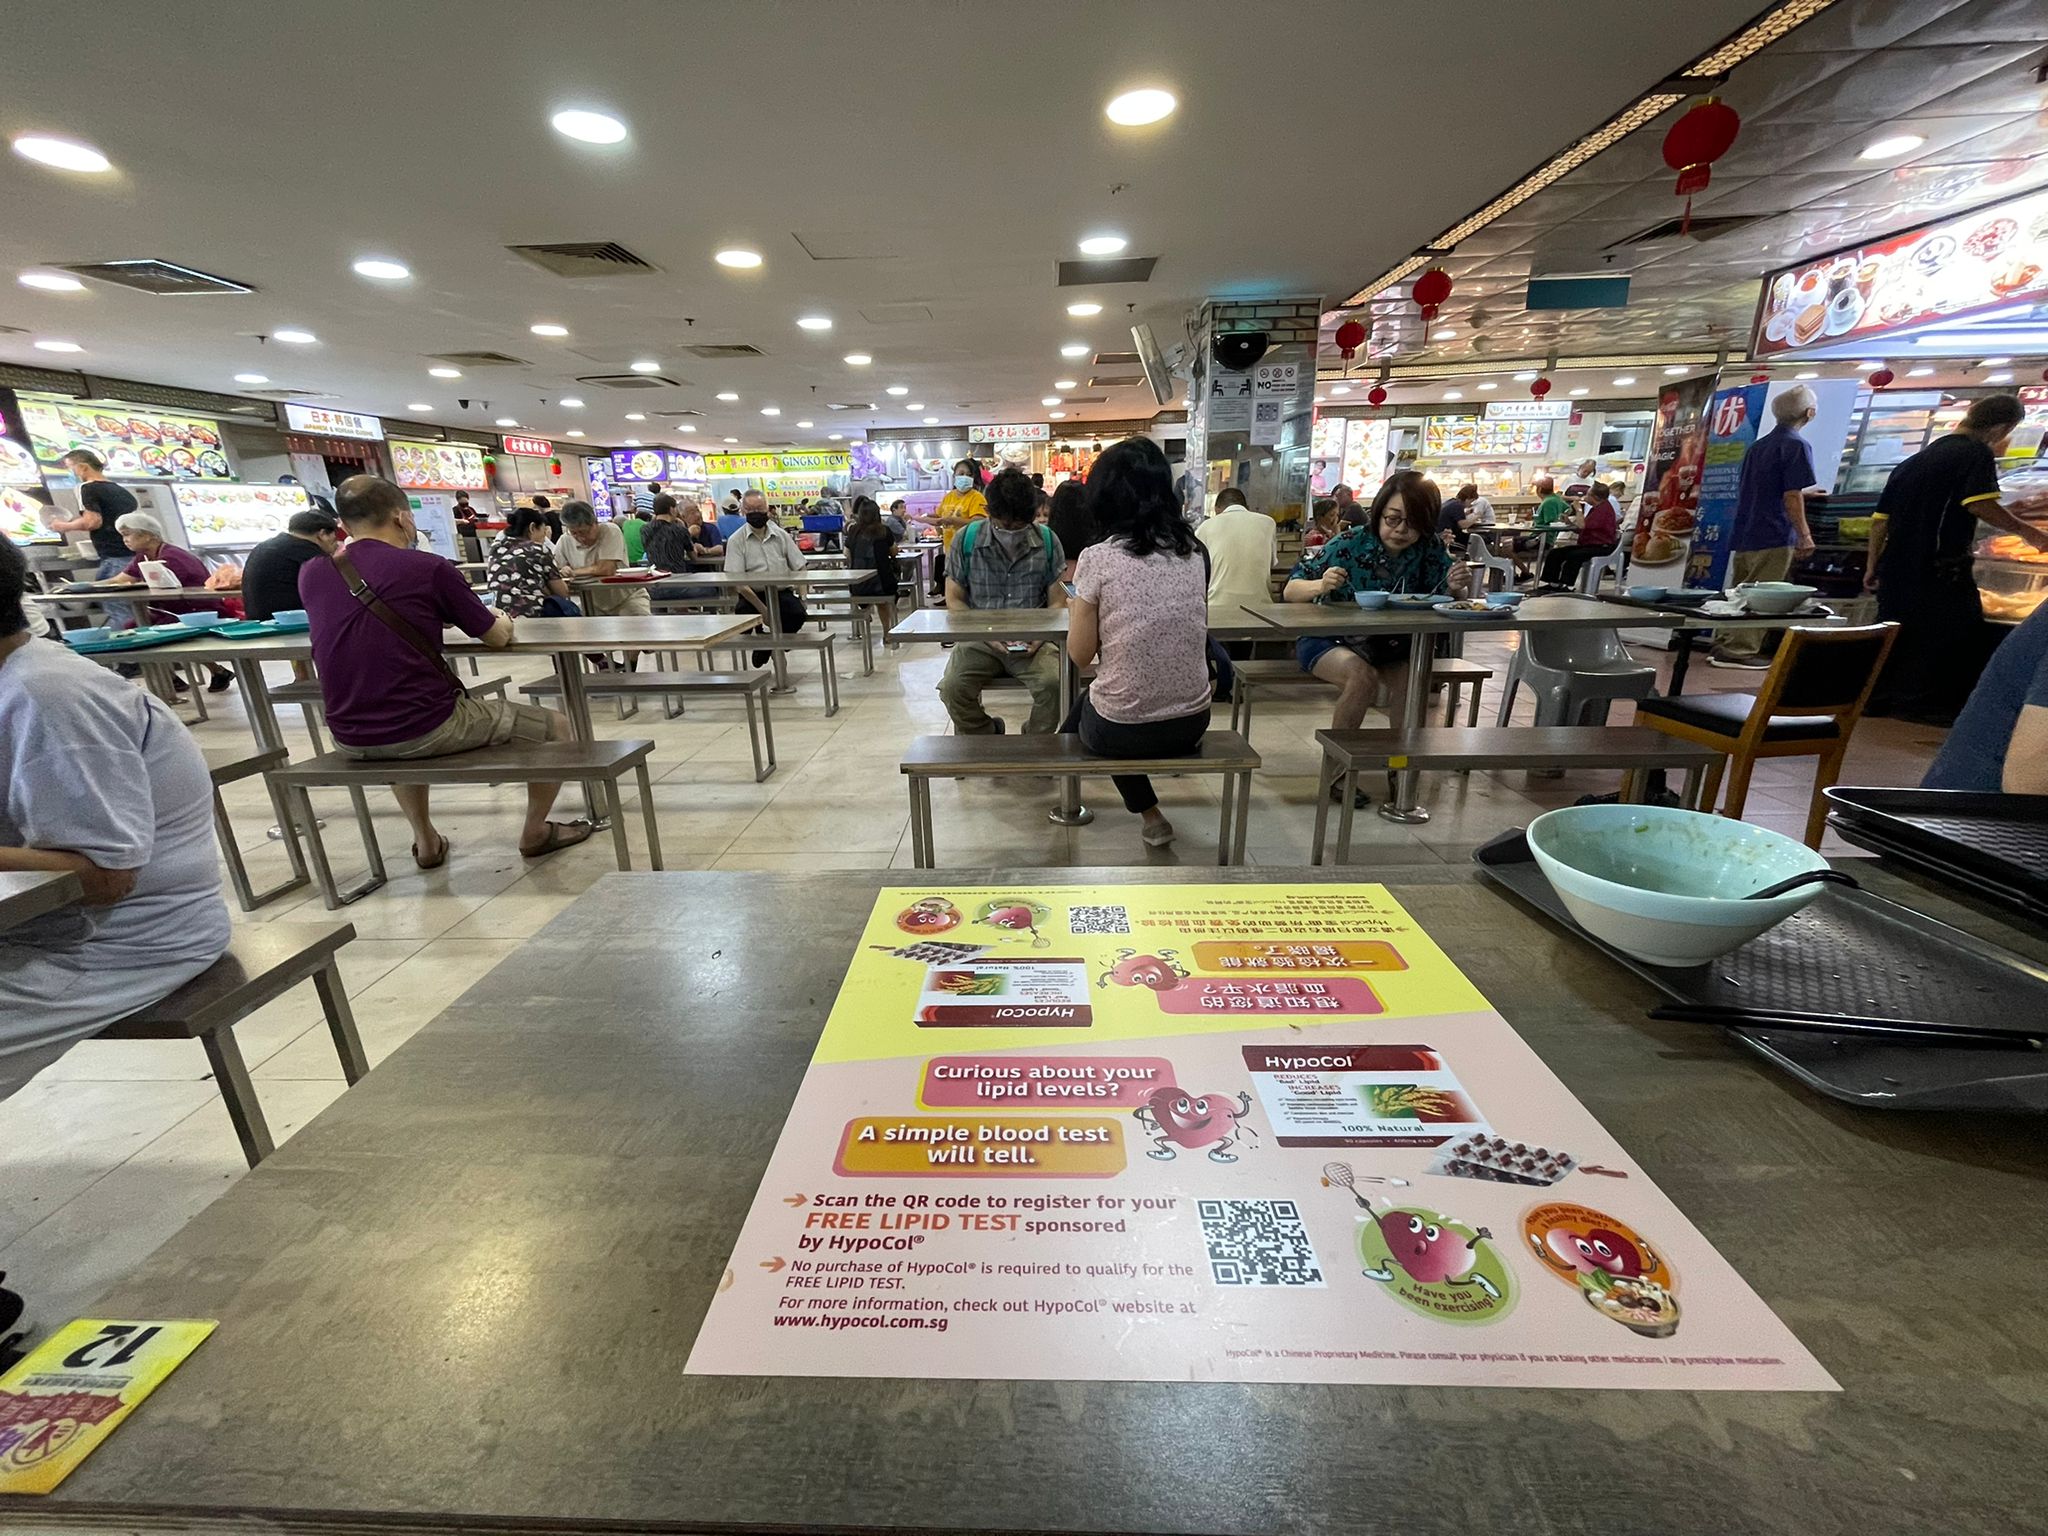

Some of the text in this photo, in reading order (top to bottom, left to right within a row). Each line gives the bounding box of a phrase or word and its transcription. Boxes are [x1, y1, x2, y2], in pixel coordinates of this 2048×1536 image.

[1257, 381, 1272, 389] NO
[782, 456, 821, 467] GINGKO
[824, 455, 844, 465] TCM
[1253, 945, 1338, 956] 揭晓了。
[1218, 956, 1374, 968] 一次检验就能
[1200, 996, 1340, 1009] 想知道您的
[995, 1007, 1075, 1018] HypoCol
[1265, 1056, 1352, 1069] HypoCol
[934, 1065, 1156, 1081] Curious about your
[976, 1081, 1119, 1099] lipid levels?
[858, 1125, 1109, 1144] A simple blood test
[927, 1146, 1035, 1162] will tell.
[813, 1194, 1176, 1212] Scan the QR code to register for your
[805, 1213, 1126, 1235] FREE LIPID TEST sponsored
[798, 1234, 824, 1252] by
[791, 1260, 811, 1272] No
[815, 1262, 882, 1275] purchase
[887, 1261, 903, 1273] of
[981, 1262, 993, 1274] is
[998, 1263, 1061, 1279] required
[1066, 1264, 1081, 1275] to
[1086, 1263, 1137, 1278] qualify
[1143, 1263, 1164, 1275] for
[1169, 1264, 1194, 1276] the
[786, 1277, 905, 1289] FREE LIPID TEST.
[1399, 1287, 1496, 1313] been exercising?
[1413, 1283, 1472, 1303] Have you
[778, 1296, 804, 1309] For
[808, 1299, 848, 1309] more
[853, 1297, 948, 1312] information,
[953, 1299, 998, 1312] check
[1003, 1300, 1029, 1312] out
[1112, 1300, 1175, 1314] website
[1180, 1301, 1197, 1314] at
[773, 1315, 948, 1332] www.hypocol.com.sg
[62, 1325, 164, 1369] 12
[1280, 1350, 1312, 1358] Chinese
[1314, 1350, 1358, 1360] Proprietary
[1359, 1351, 1398, 1359] Medicine.
[1399, 1351, 1426, 1360] Please
[1428, 1352, 1458, 1360] consult
[1459, 1353, 1478, 1362] your
[1479, 1352, 1519, 1362] physician
[1527, 1354, 1544, 1363] you
[1559, 1354, 1588, 1364] taking
[1669, 1357, 1686, 1365] any
